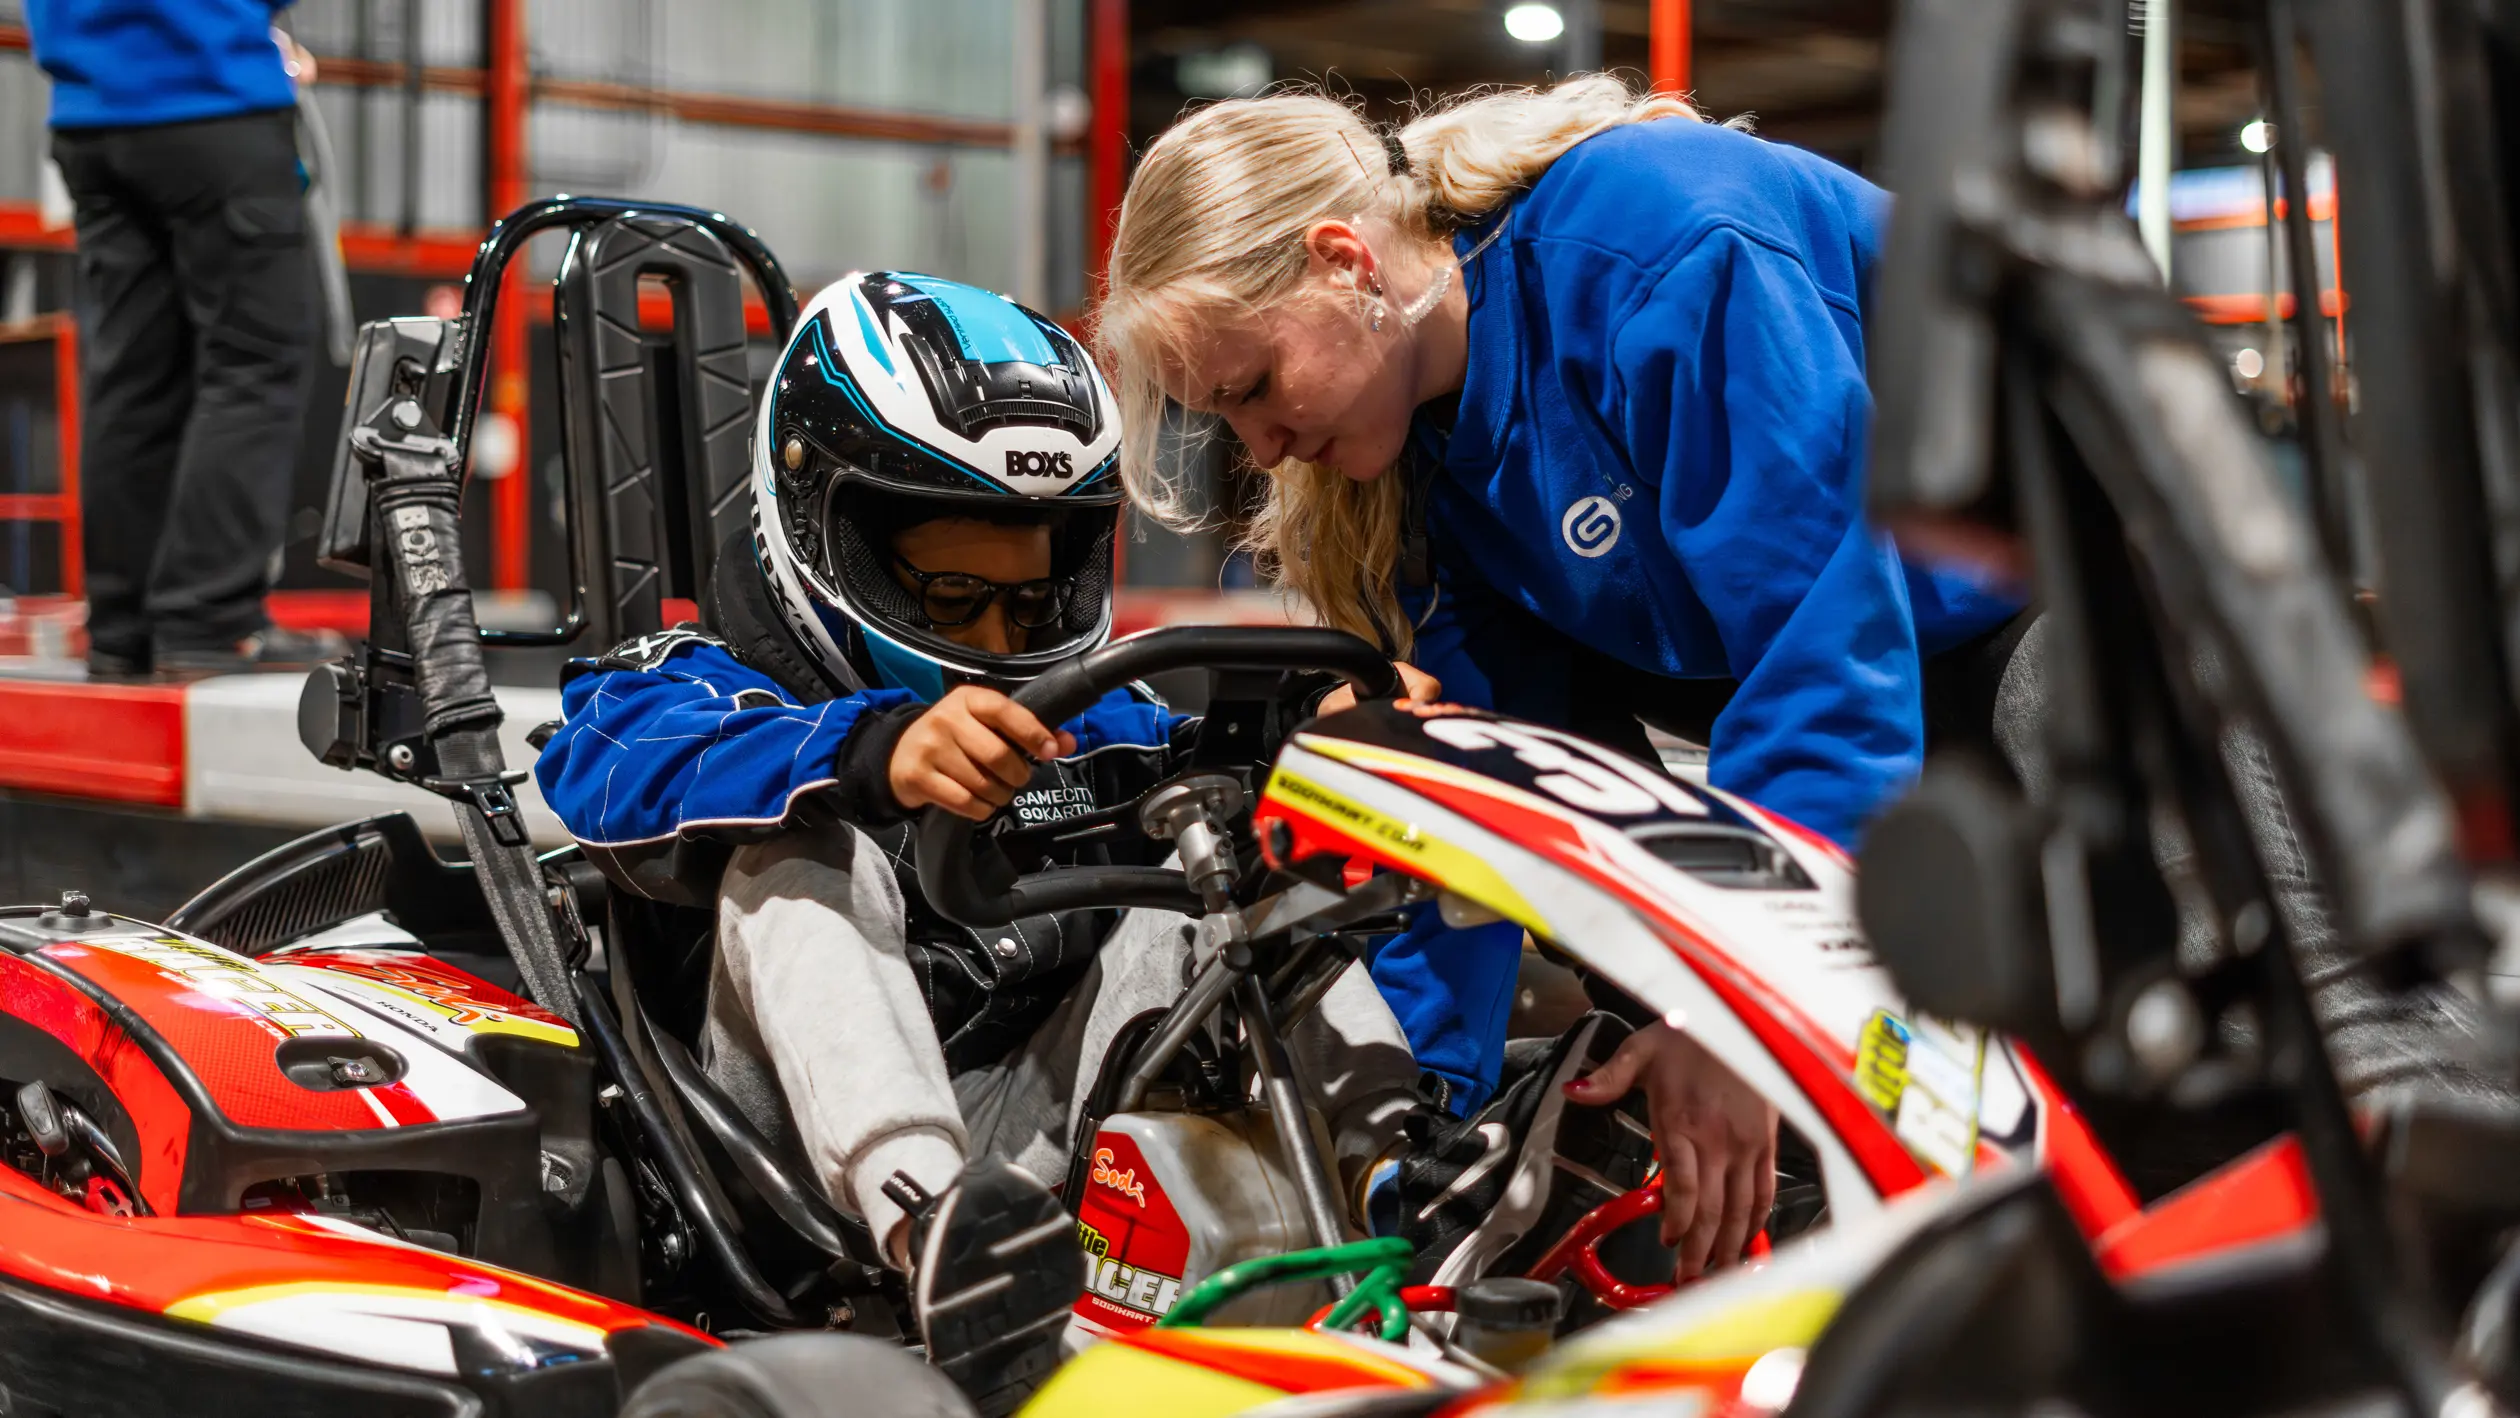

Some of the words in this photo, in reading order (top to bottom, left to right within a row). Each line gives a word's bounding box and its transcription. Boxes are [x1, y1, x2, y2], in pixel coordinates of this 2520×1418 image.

[1005, 451, 1074, 479] BOX'S
[1423, 718, 1710, 816] 31
[376, 1000, 439, 1033] HONDA
[1093, 1148, 1146, 1209] Sodi
[1091, 1296, 1164, 1326] SODIKART.
